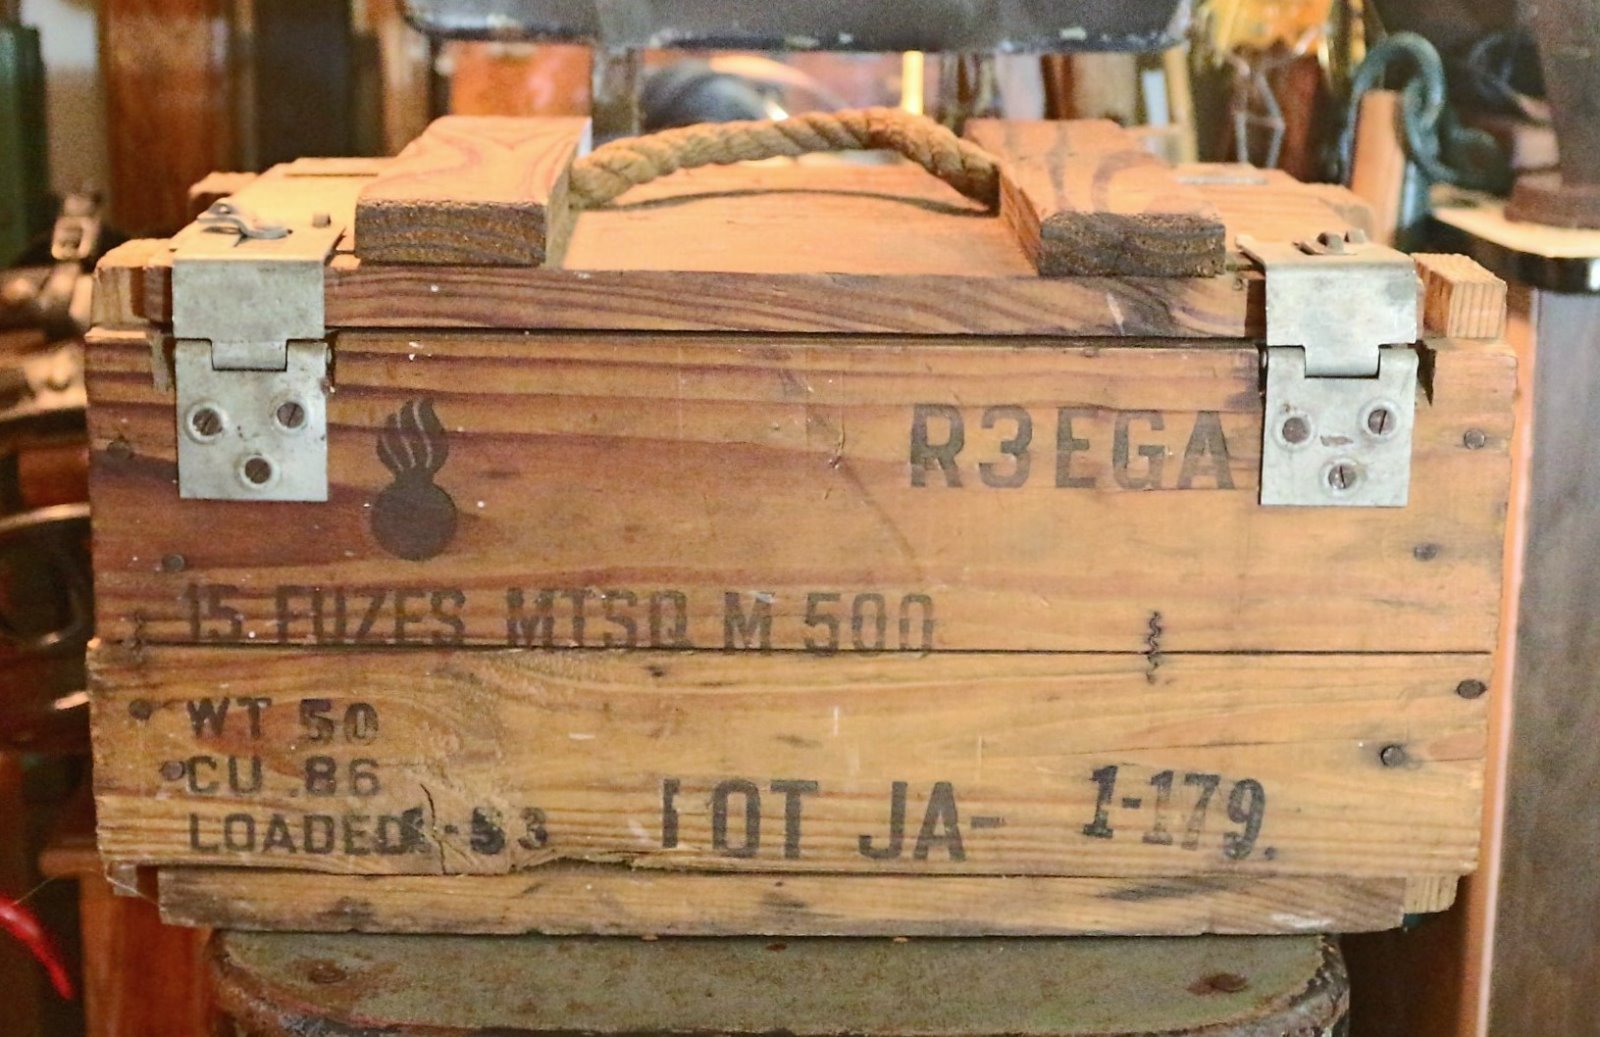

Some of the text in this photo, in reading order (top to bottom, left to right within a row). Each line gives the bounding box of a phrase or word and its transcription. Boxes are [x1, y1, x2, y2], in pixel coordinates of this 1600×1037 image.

[908, 403, 1237, 490] R3EGA
[186, 698, 379, 746] WT 50
[187, 755, 263, 793] CU
